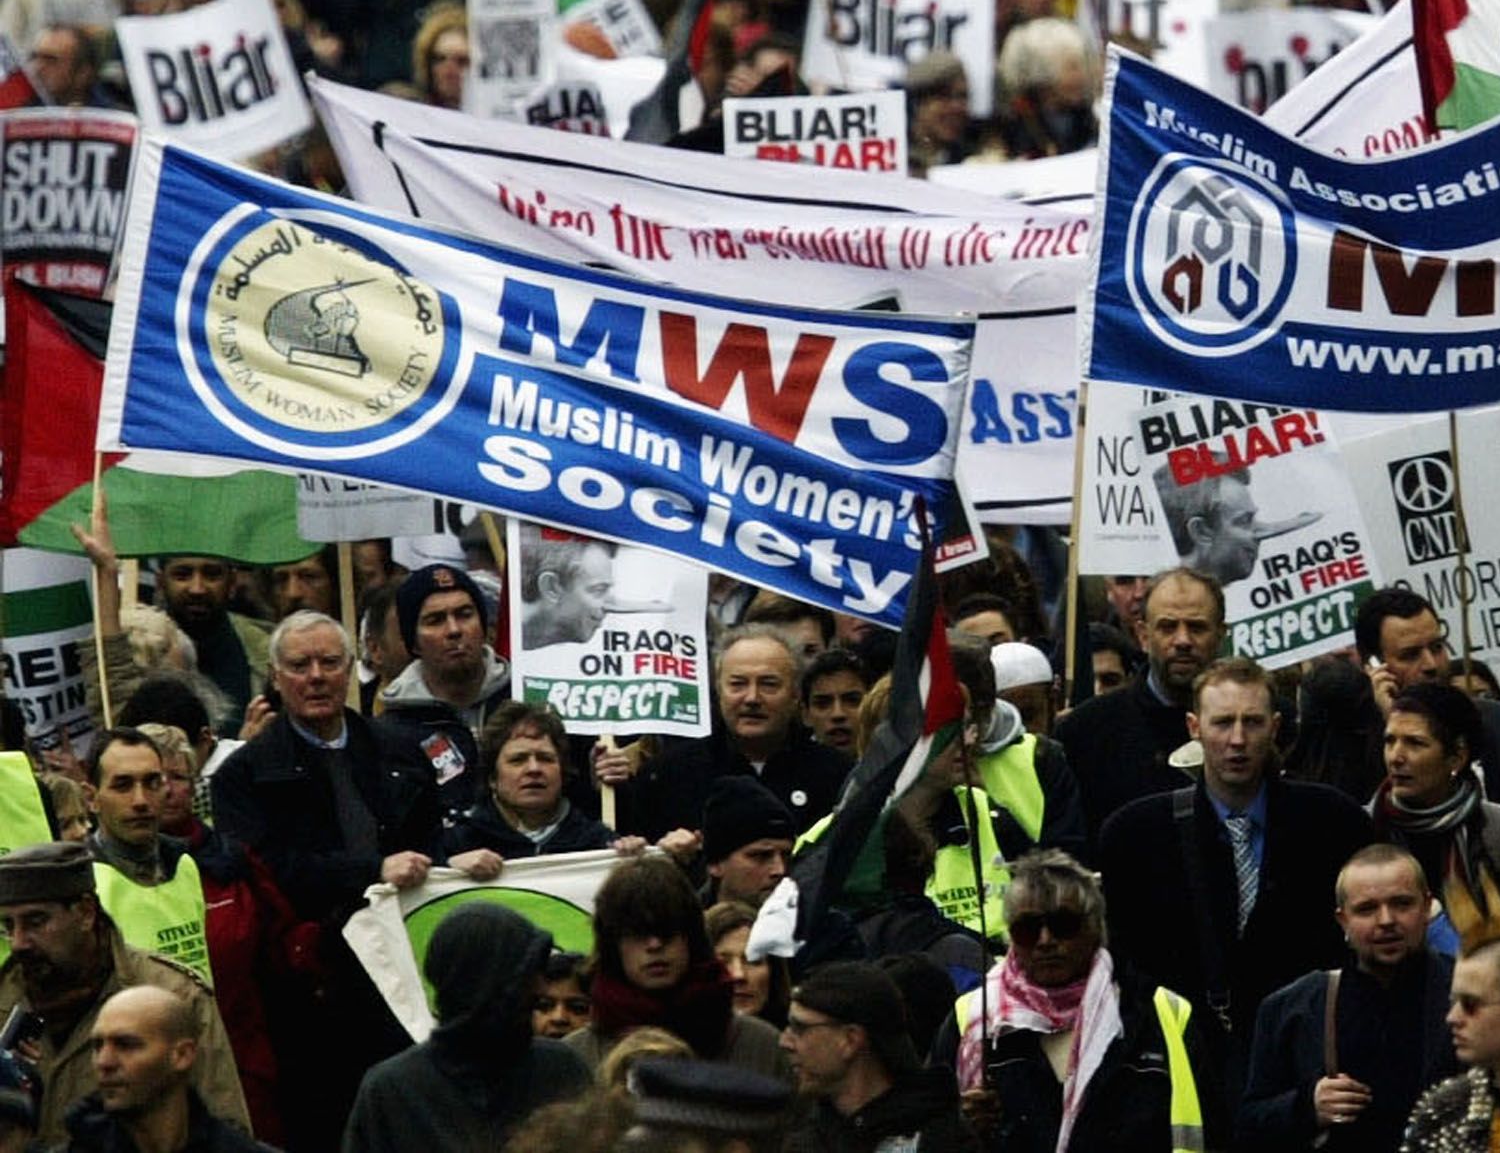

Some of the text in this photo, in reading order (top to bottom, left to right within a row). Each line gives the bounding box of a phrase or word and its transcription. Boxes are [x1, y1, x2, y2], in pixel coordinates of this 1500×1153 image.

[145, 28, 280, 127] Bliar
[736, 105, 876, 143] BLIAR!
[4, 141, 117, 186] SHUT
[3, 187, 122, 236] DOWN
[217, 313, 429, 424] MUSLIM WOMAN SOCIETY
[499, 277, 950, 468] MWS
[970, 378, 1077, 444] ASS
[487, 373, 936, 554] Muslim Women's
[1167, 409, 1326, 487] BLIAR!
[477, 434, 911, 612] Society
[1250, 554, 1370, 610] ON FIRE
[1262, 531, 1362, 581] IRAQ'S
[603, 629, 698, 658] IRAQ'S
[1232, 591, 1355, 658] RESPECT
[580, 653, 698, 681] ON FIRE
[547, 680, 680, 719] RESPECT
